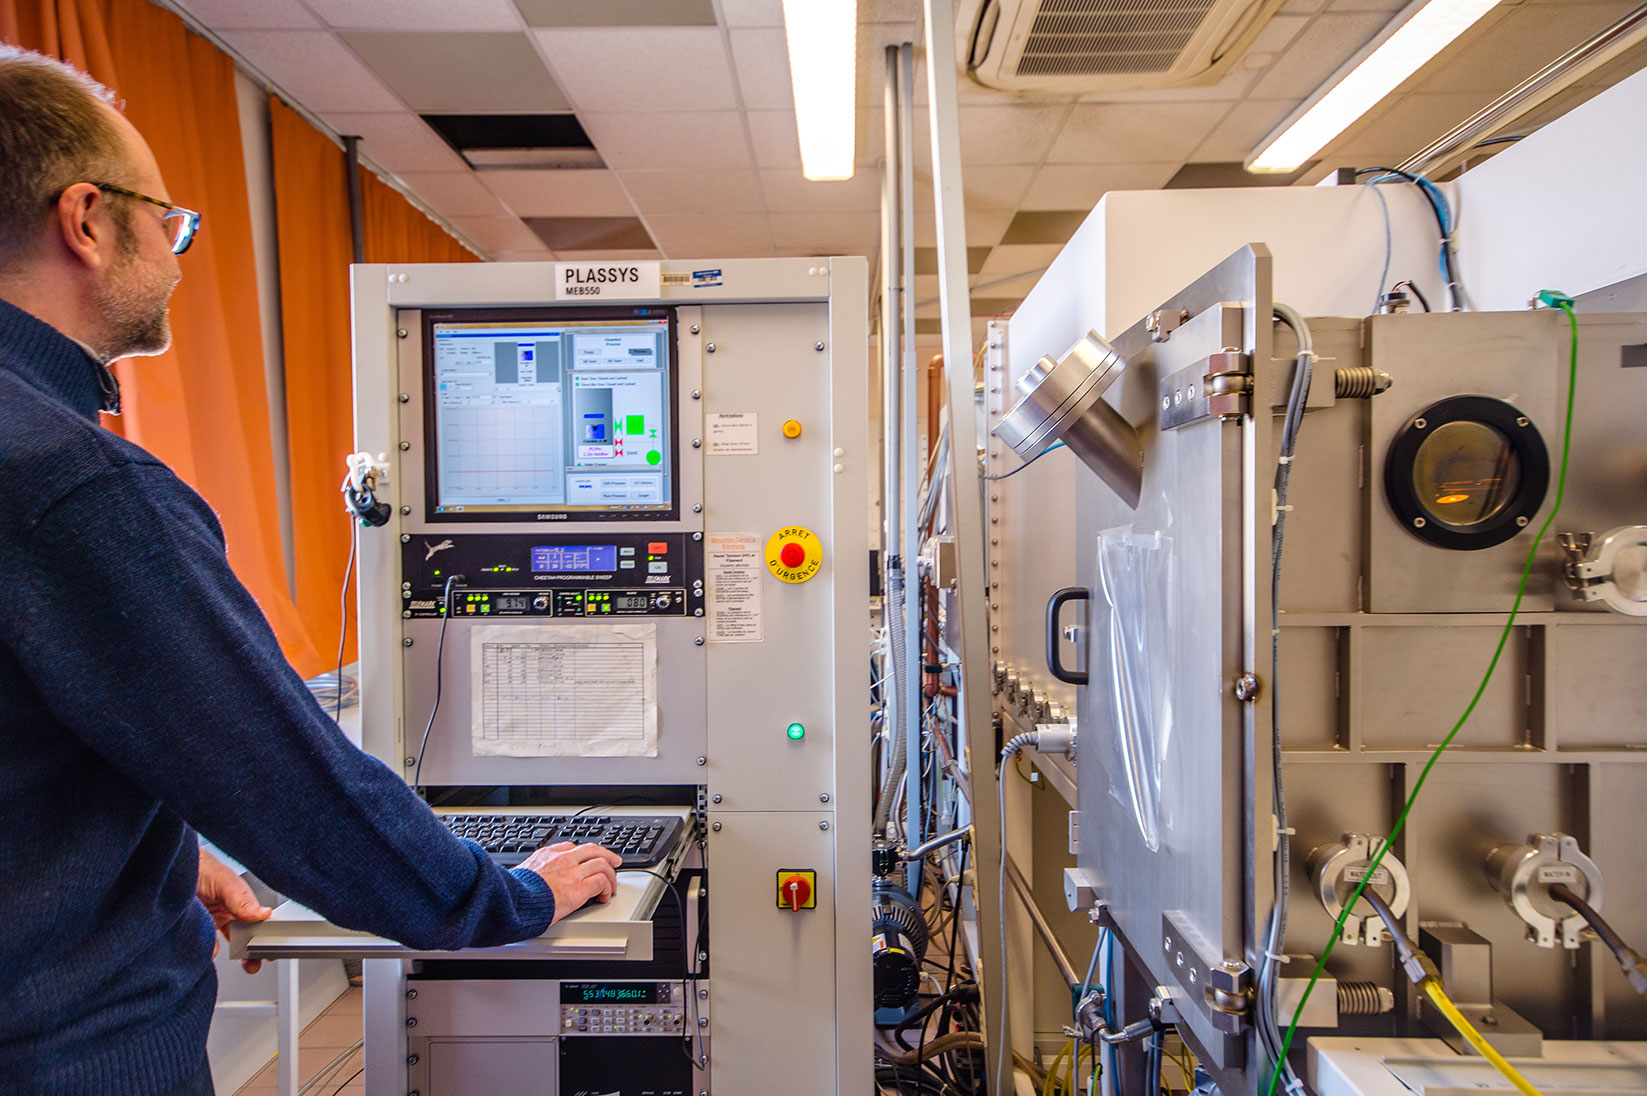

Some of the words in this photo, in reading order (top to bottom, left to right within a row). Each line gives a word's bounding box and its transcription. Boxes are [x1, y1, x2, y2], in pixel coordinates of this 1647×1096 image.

[565, 267, 639, 283] PLASSYS
[565, 286, 600, 295] MEB550
[537, 513, 568, 521] SAMSUNG
[779, 528, 810, 540] ARRET
[769, 559, 819, 580] D'URGENCE
